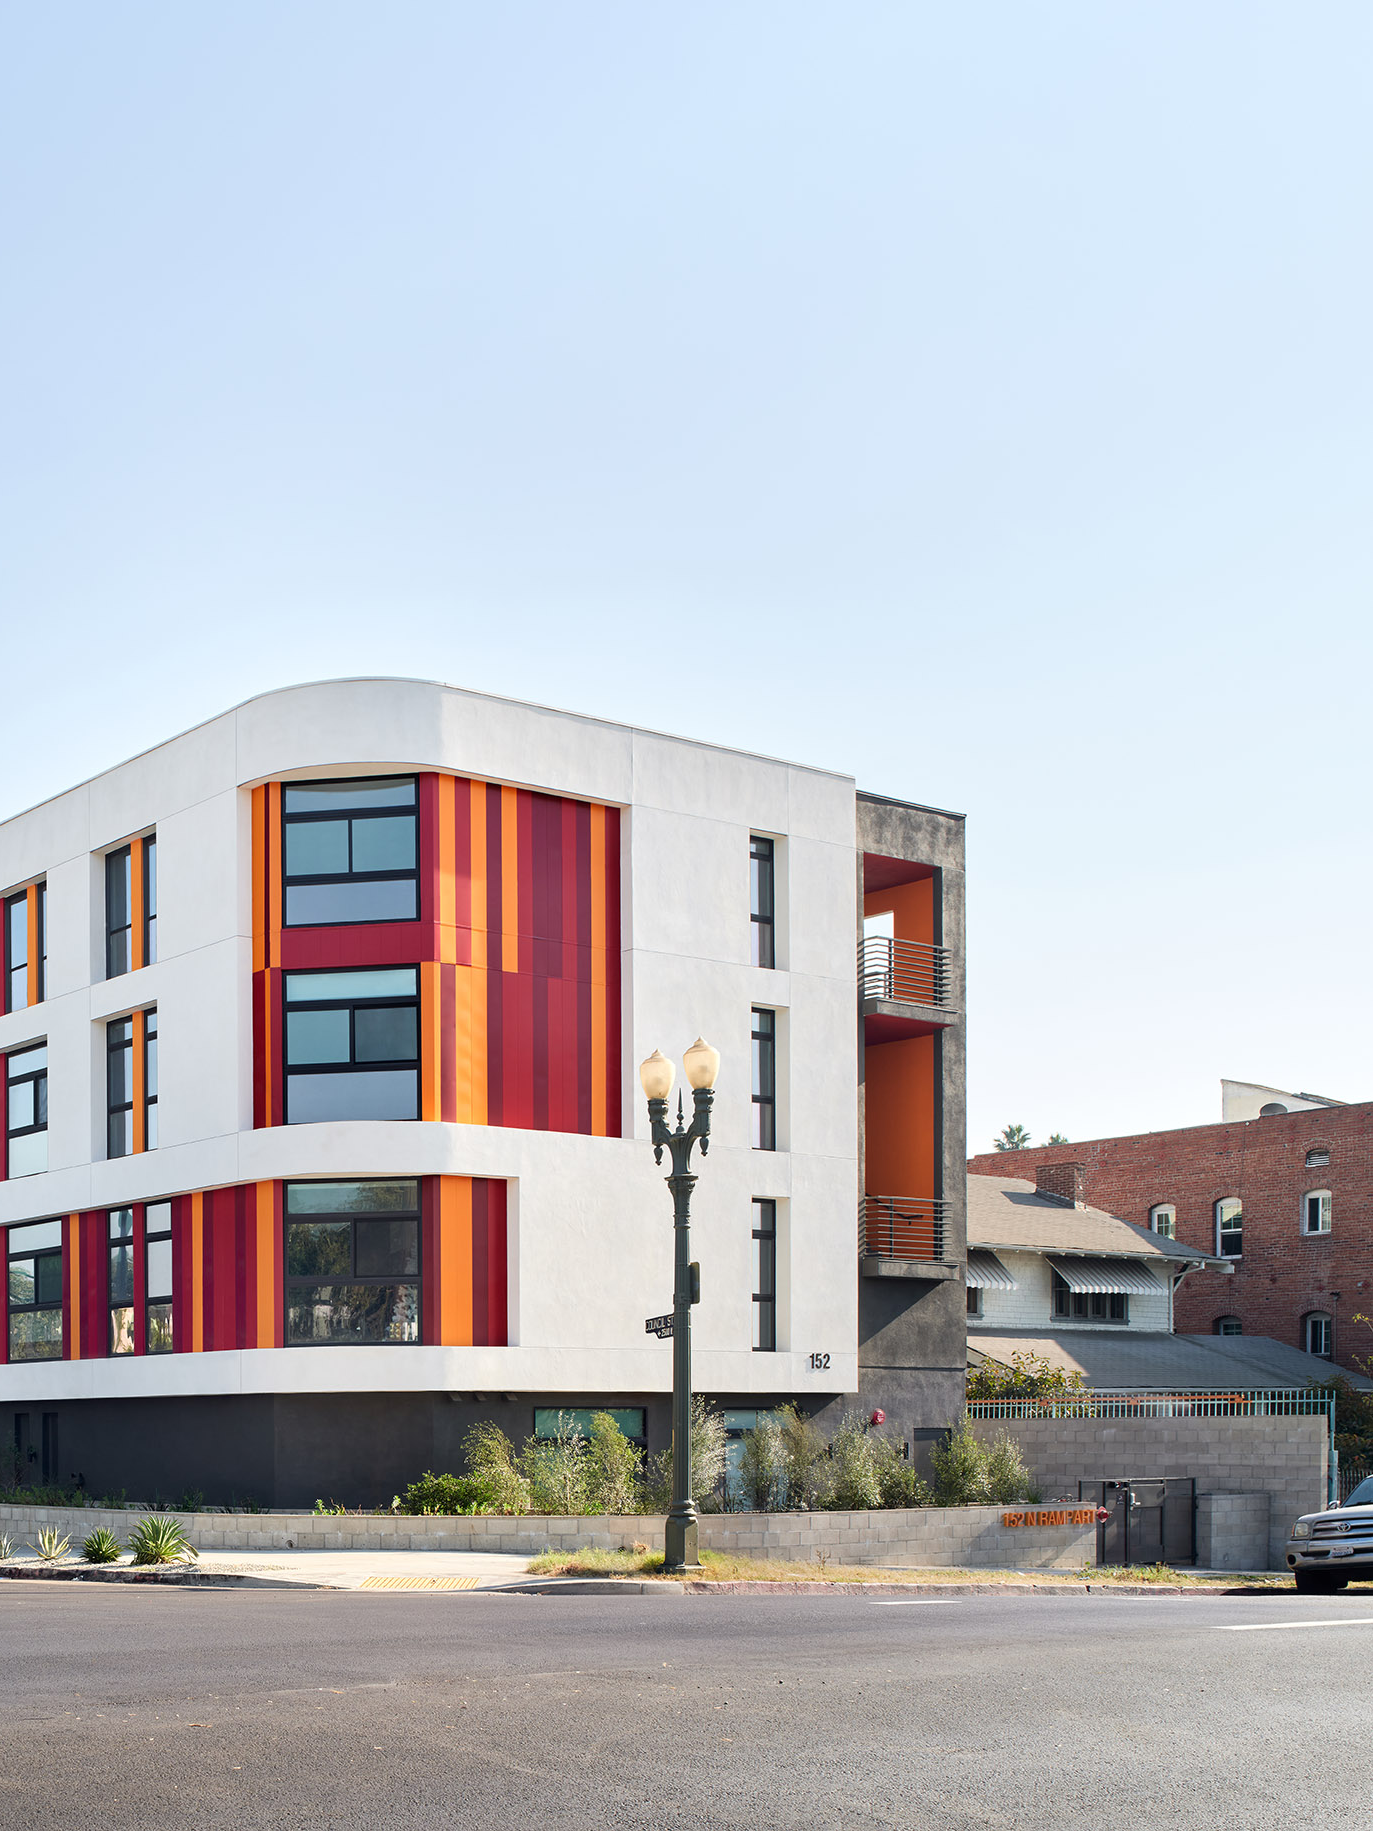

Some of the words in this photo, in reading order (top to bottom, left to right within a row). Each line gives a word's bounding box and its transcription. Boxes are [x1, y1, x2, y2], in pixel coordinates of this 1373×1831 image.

[809, 1353, 831, 1369] 152
[1002, 1512, 1025, 1527] 152
[1026, 1511, 1037, 1527] N
[1038, 1509, 1097, 1526] RAMPART
